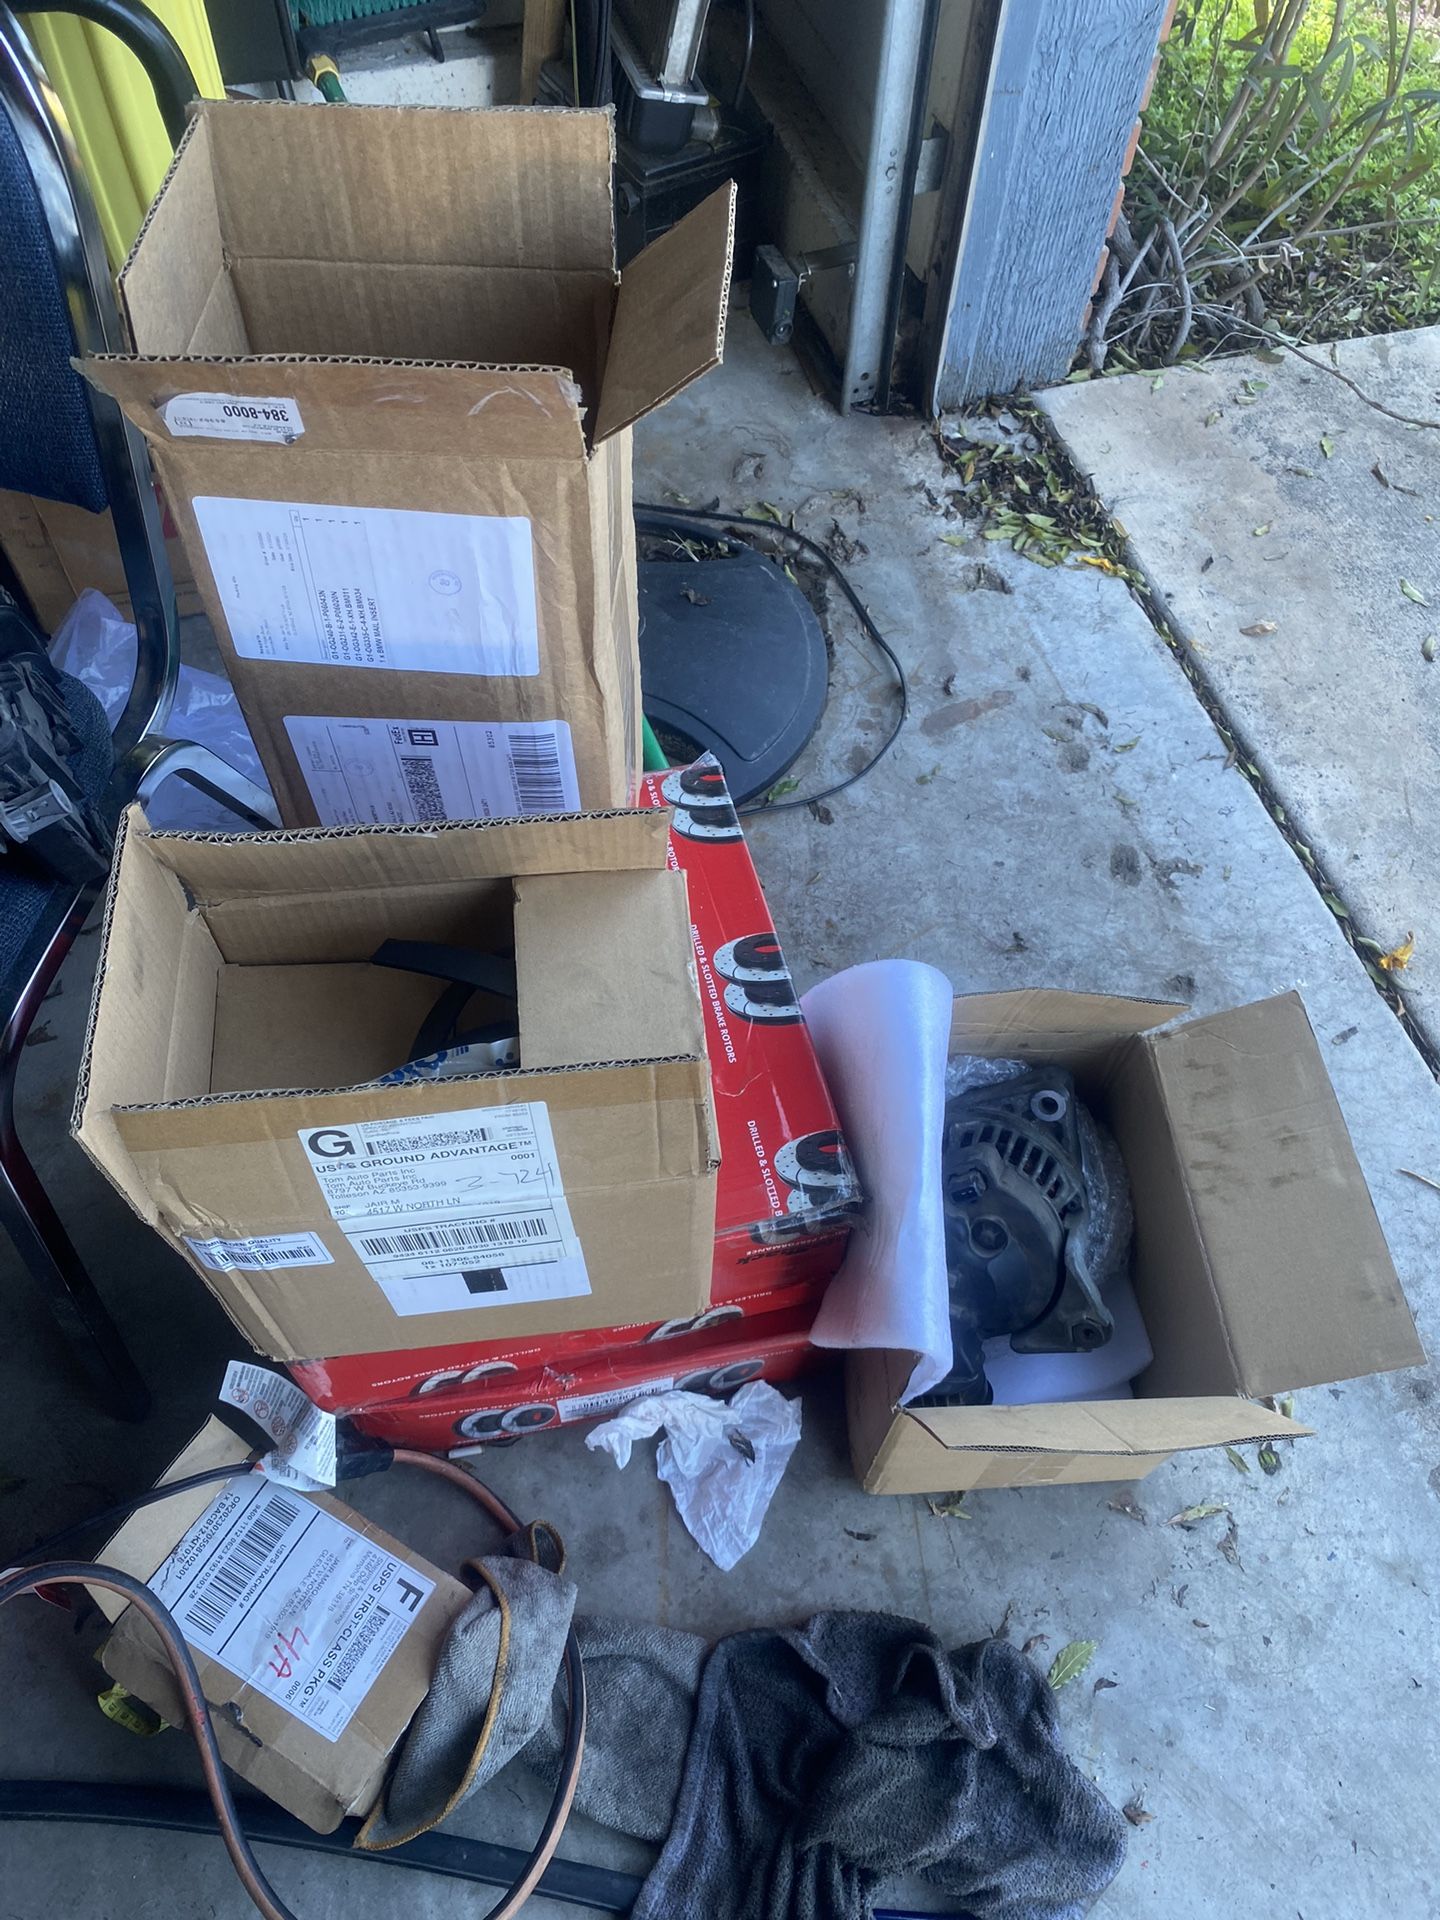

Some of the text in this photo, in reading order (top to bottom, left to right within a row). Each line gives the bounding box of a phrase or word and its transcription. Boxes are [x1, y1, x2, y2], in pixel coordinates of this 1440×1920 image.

[221, 404, 288, 423] 384-8000
[367, 597, 379, 621] INSERT
[388, 726, 405, 744] FedEx
[690, 924, 737, 1064] DRILLED & SLOTTED BRAKE ROTORS
[303, 1127, 356, 1159] G
[747, 1120, 765, 1158] DRILLED
[358, 1152, 426, 1168] GROUND
[510, 1152, 535, 1160] 0001
[759, 1158, 768, 1168] &
[323, 1175, 345, 1183] Tom
[366, 1180, 410, 1190] Buckeye
[761, 1167, 781, 1209] SLOTTED
[329, 1190, 372, 1199] Tolleson
[392, 1204, 407, 1212] W
[405, 1199, 444, 1210] NORTH
[445, 1197, 461, 1205] LN
[402, 1224, 433, 1232] USPS
[433, 1218, 486, 1229] TRACKING
[501, 1347, 541, 1359] DRILLED
[413, 1367, 444, 1379] BRAKE
[447, 1357, 489, 1371] SLOTTED
[371, 1374, 411, 1387] ROTORS
[232, 1520, 250, 1537] 1112
[268, 1543, 287, 1564] USPS
[298, 1548, 329, 1588] GLENDALE
[314, 1568, 324, 1578] W
[348, 1548, 372, 1580] Memphis
[360, 1556, 384, 1586] Shipping
[241, 1563, 272, 1602] TRACKING
[300, 1556, 341, 1611] JAIR MARQUEZ
[342, 1579, 352, 1590] TN
[371, 1561, 397, 1593] USPS
[291, 1586, 303, 1599] AZ
[296, 1577, 318, 1605] NORTH
[387, 1577, 424, 1612] F
[288, 1604, 300, 1616] LN
[333, 1591, 360, 1626] Receiving
[321, 1593, 376, 1669] FIRST-CLASS
[284, 1679, 301, 1700] 0006
